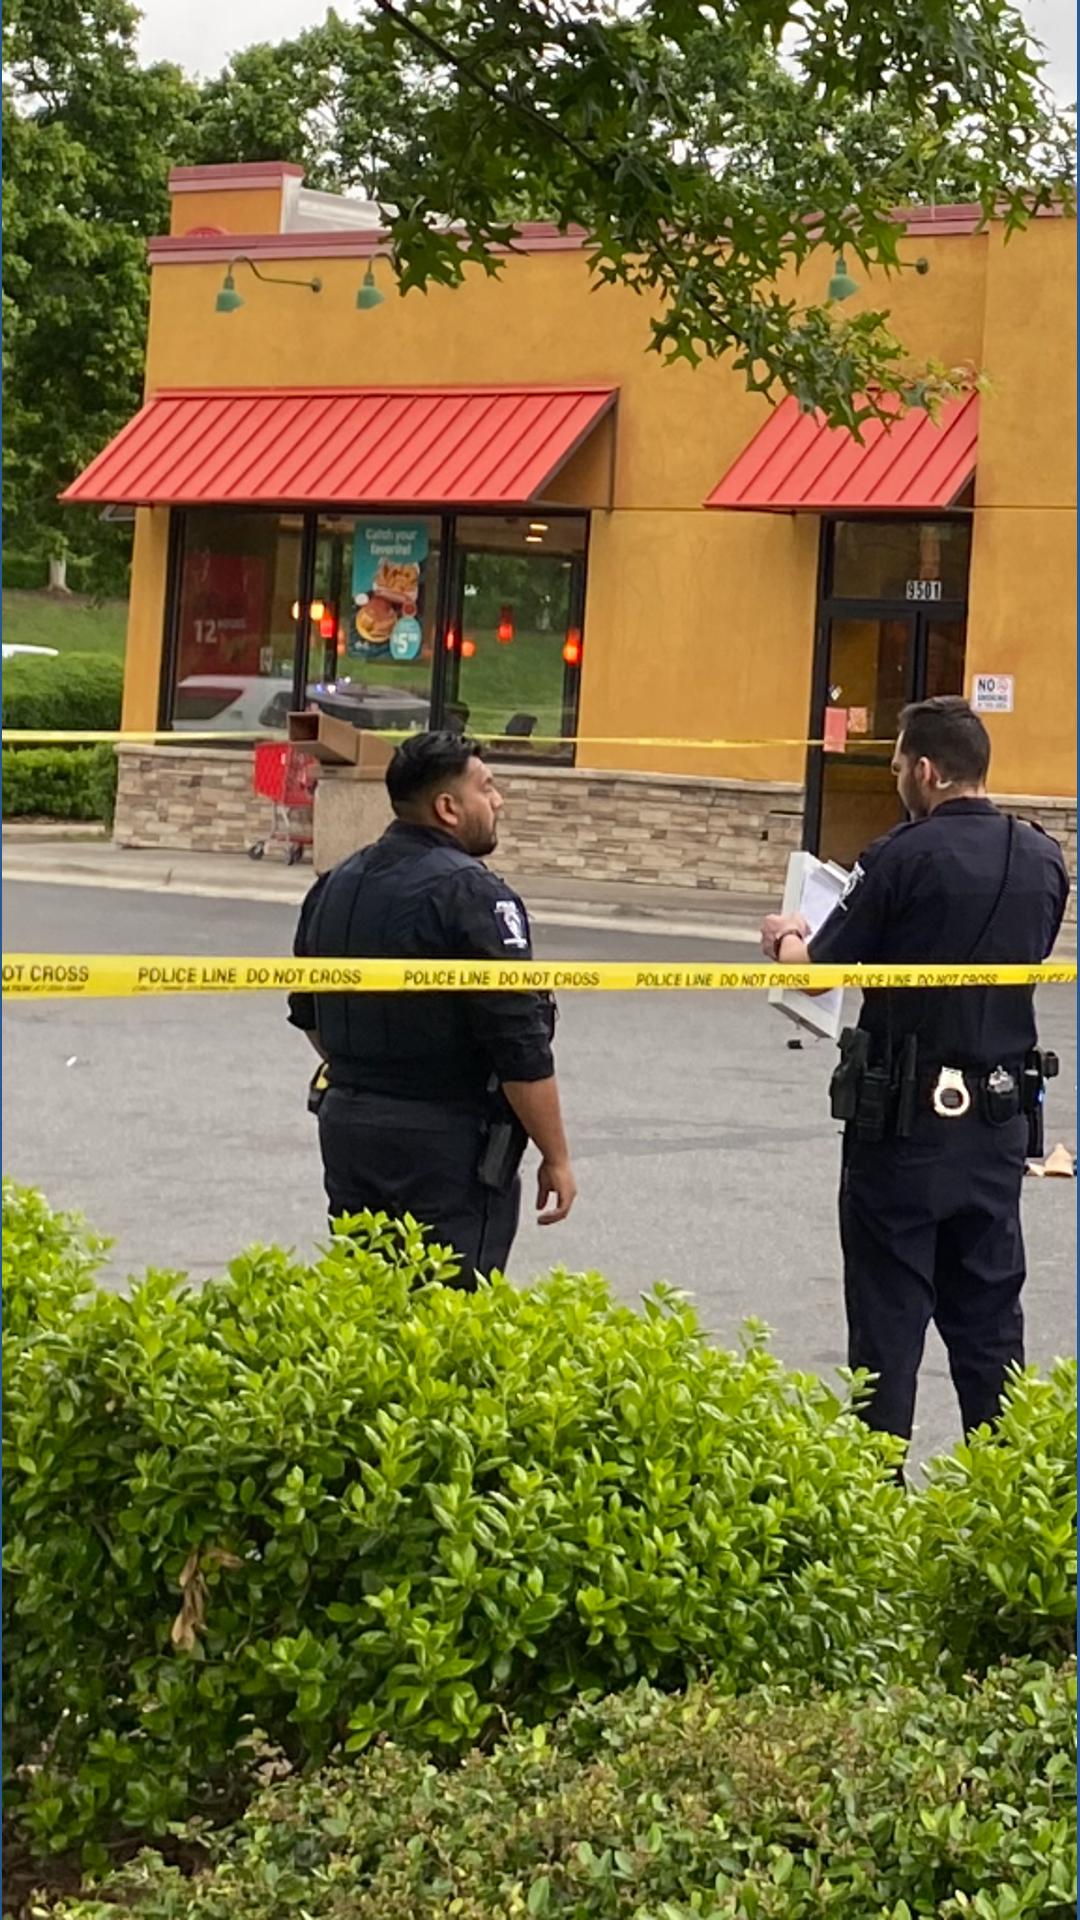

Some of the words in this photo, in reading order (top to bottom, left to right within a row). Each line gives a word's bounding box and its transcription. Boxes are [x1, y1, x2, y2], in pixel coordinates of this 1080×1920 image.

[365, 528, 394, 540] Catch
[907, 581, 940, 599] 9501
[194, 619, 218, 644] 12
[977, 678, 996, 692] NO
[30, 965, 89, 983] CROSS
[137, 967, 198, 983] POLICE
[202, 967, 237, 984] LINE
[246, 967, 270, 984] DO
[273, 968, 306, 984] NOT
[309, 969, 362, 985] CROSS
[403, 970, 456, 986] POLICE
[459, 971, 490, 986] LINE
[498, 971, 519, 986] DO
[522, 972, 551, 986] NOT
[554, 972, 600, 987] CROSS
[636, 973, 682, 986] POLICE
[686, 974, 713, 986] LINE
[720, 974, 739, 987] DO
[742, 974, 766, 987] NOT
[769, 974, 810, 986] CROSS
[842, 974, 884, 985] POLICE
[887, 974, 912, 985] LINE
[918, 974, 934, 985] DO
[937, 974, 959, 985] NOT
[961, 973, 999, 985] CROSS
